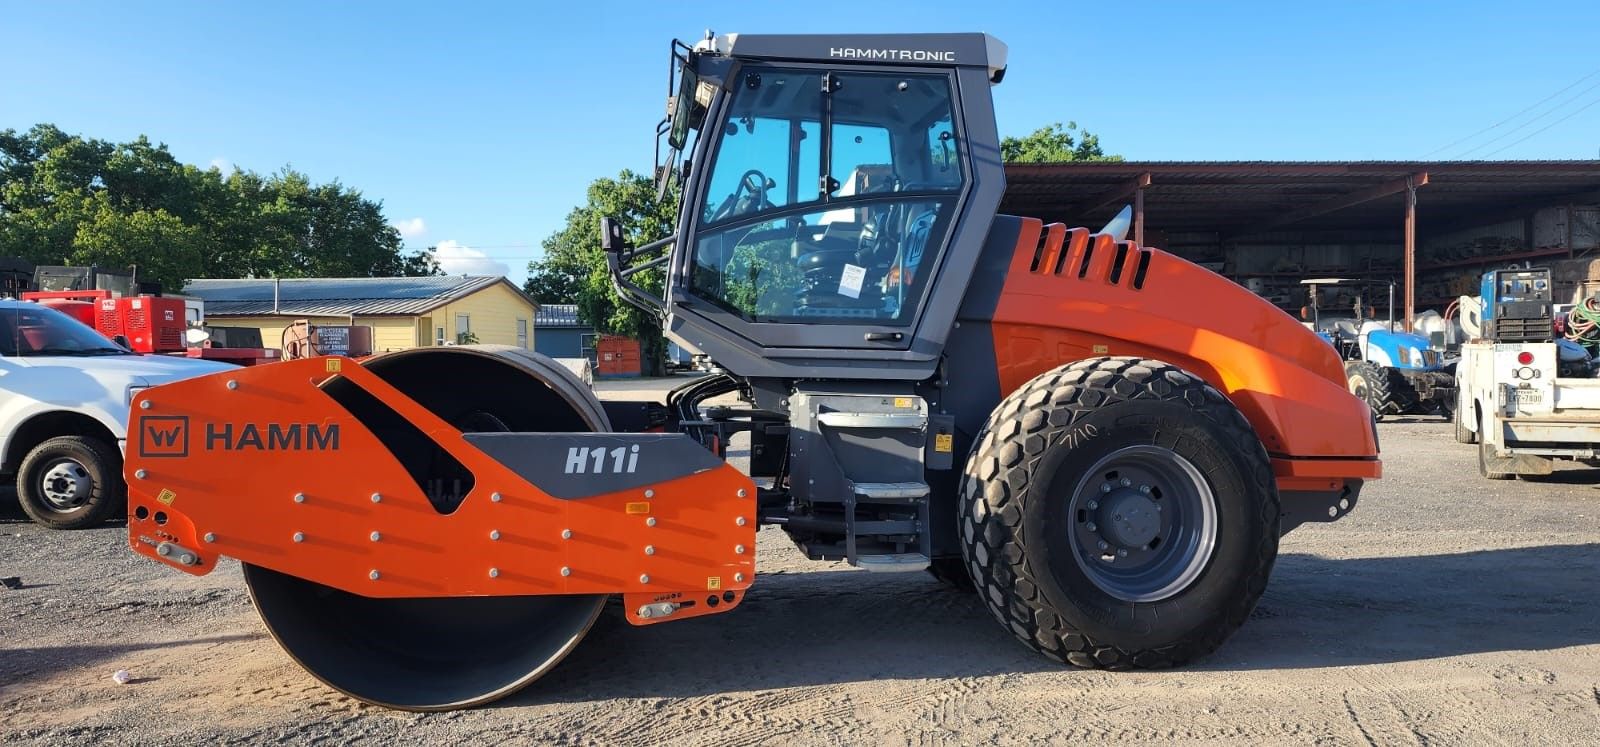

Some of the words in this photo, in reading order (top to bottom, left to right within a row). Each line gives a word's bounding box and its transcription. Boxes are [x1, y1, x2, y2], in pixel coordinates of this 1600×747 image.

[830, 47, 955, 61] HAMMTRONIC
[206, 423, 339, 450] HAMM
[564, 444, 640, 474] H11i
